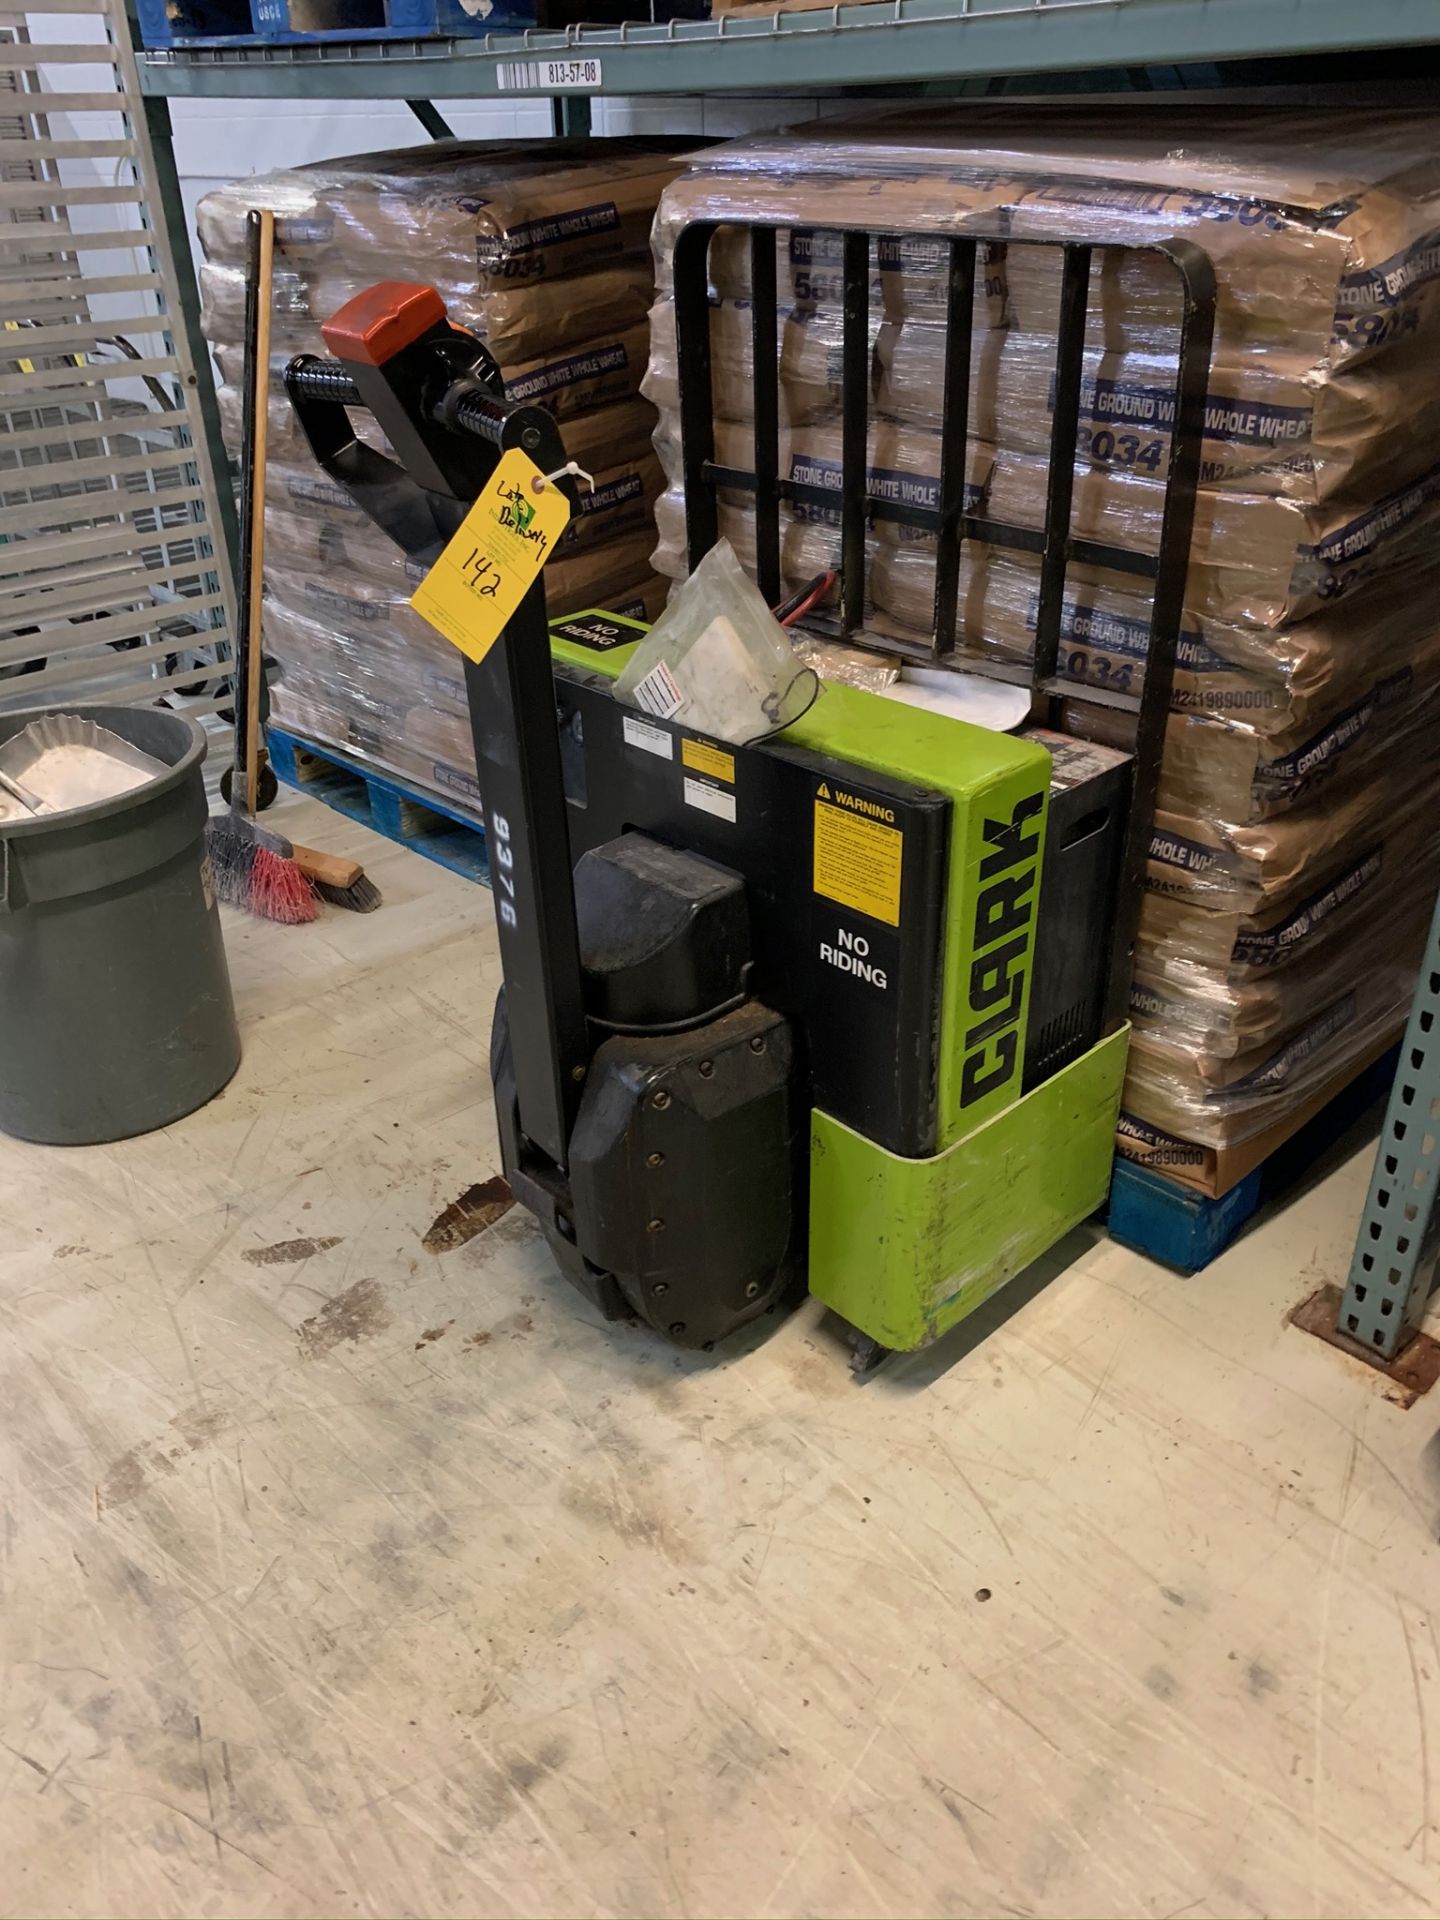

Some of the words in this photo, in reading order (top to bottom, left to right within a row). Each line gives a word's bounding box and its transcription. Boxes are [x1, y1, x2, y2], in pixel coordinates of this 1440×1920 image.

[548, 61, 596, 84] 813-57-08
[531, 223, 560, 242] WHITE
[559, 216, 588, 235] WHOLE
[587, 208, 616, 229] WHEAT
[1338, 279, 1385, 306] TONE
[514, 375, 549, 400] GROUND
[549, 366, 572, 386] WHITE
[570, 359, 599, 378] WHOLE
[598, 350, 626, 369] WHEAT
[1098, 391, 1155, 420] GROUND
[1205, 407, 1257, 435] WHOLE
[792, 464, 823, 486] STONE
[866, 477, 900, 499] WHITE
[900, 480, 937, 505] WHOLE
[462, 547, 502, 598] 142
[559, 624, 617, 646] RIDING
[588, 623, 619, 636] NO
[1073, 616, 1127, 643] GROUND
[834, 789, 895, 824] WARNING
[837, 928, 870, 957] NO
[960, 790, 1045, 1109] CLARK
[819, 942, 888, 990] RIDING
